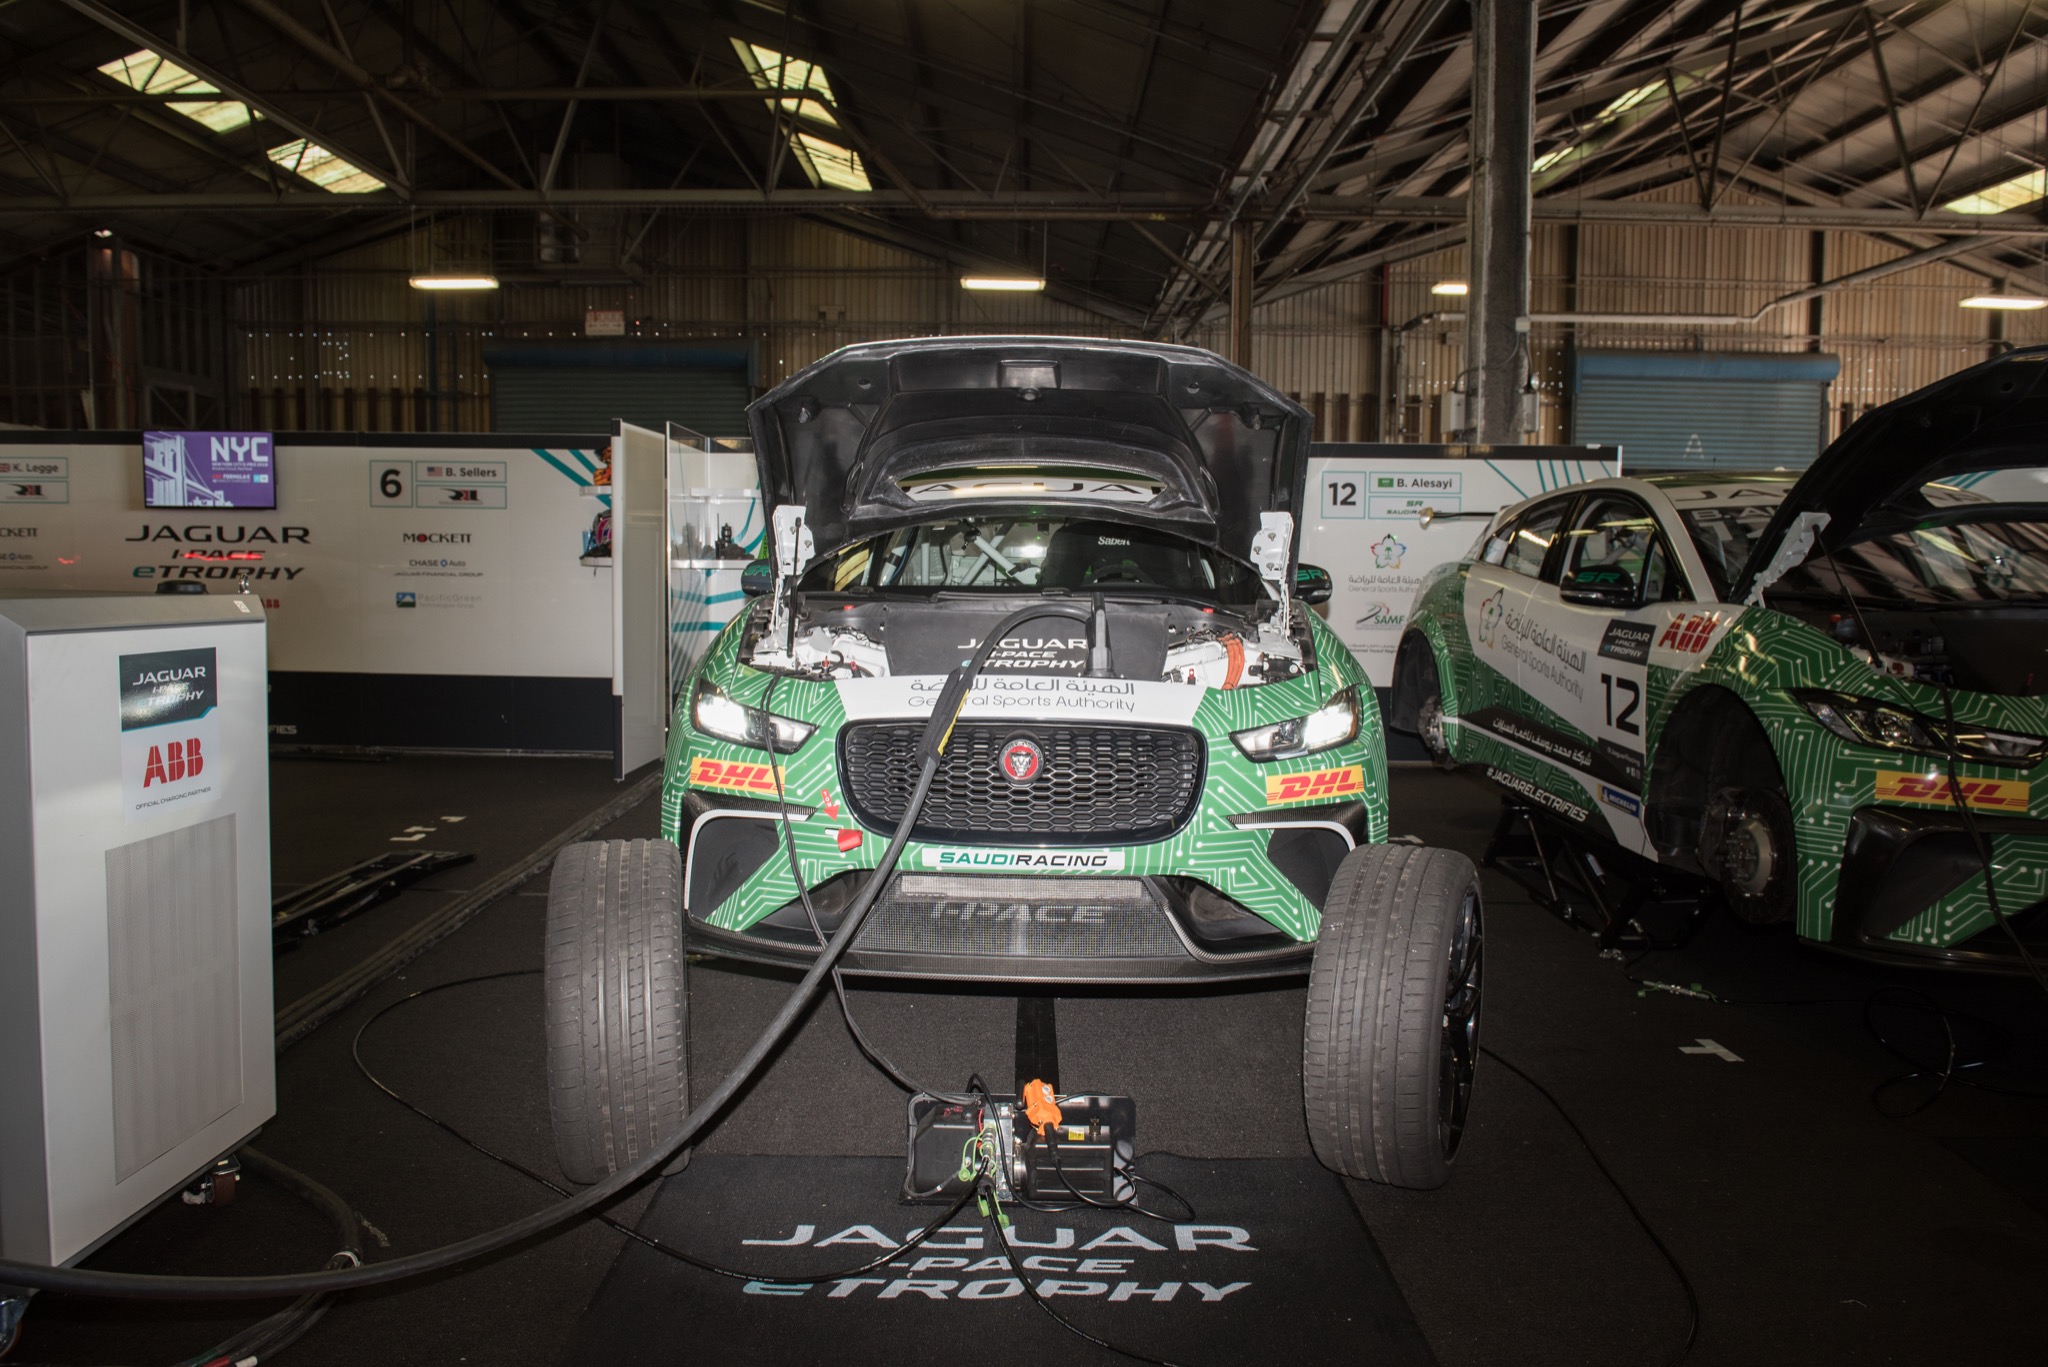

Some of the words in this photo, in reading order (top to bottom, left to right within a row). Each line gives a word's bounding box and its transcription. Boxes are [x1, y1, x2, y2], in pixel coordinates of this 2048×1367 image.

[210, 436, 268, 462] NYC
[26, 463, 59, 475] Legge
[445, 467, 457, 477] B.
[460, 467, 497, 478] Sellers
[380, 468, 403, 498] 6
[1397, 478, 1408, 488] B.
[1411, 478, 1453, 489] Alesayi
[1328, 482, 1357, 506] 12
[125, 525, 311, 544] JAGUAR
[402, 532, 472, 544] MOCKETT
[132, 565, 305, 580] eTROPHY
[408, 559, 439, 568] CHASE
[449, 559, 466, 567] Auto
[1575, 571, 1621, 584] SR
[261, 598, 280, 609] BB
[958, 638, 1088, 650] JGUAR
[1608, 627, 1651, 643] JAGUAR
[990, 650, 1058, 658] I-PACE
[1502, 634, 1528, 663] General
[132, 666, 206, 686] JAGUAR
[993, 678, 1060, 692] العامة
[1066, 679, 1135, 696] الهيئة
[908, 695, 988, 707] Geral
[993, 695, 1051, 708] Sports
[1056, 695, 1135, 713] Authority
[1601, 672, 1641, 737] 12
[143, 737, 204, 788] ABB
[697, 761, 776, 790] DHL
[1278, 769, 1358, 800] DHL
[135, 798, 160, 811] OFFICIAL
[160, 792, 188, 804] CHARGING
[187, 787, 212, 798] PARTNER
[1486, 767, 1589, 822] #JAGUARELECTRIFIES
[1894, 777, 2008, 805] DHL
[1609, 794, 1638, 812] MICHELIN
[939, 851, 1108, 867] SAUDIRACING
[741, 1224, 1260, 1252] JAGUAR
[866, 1255, 1136, 1274] -PACE
